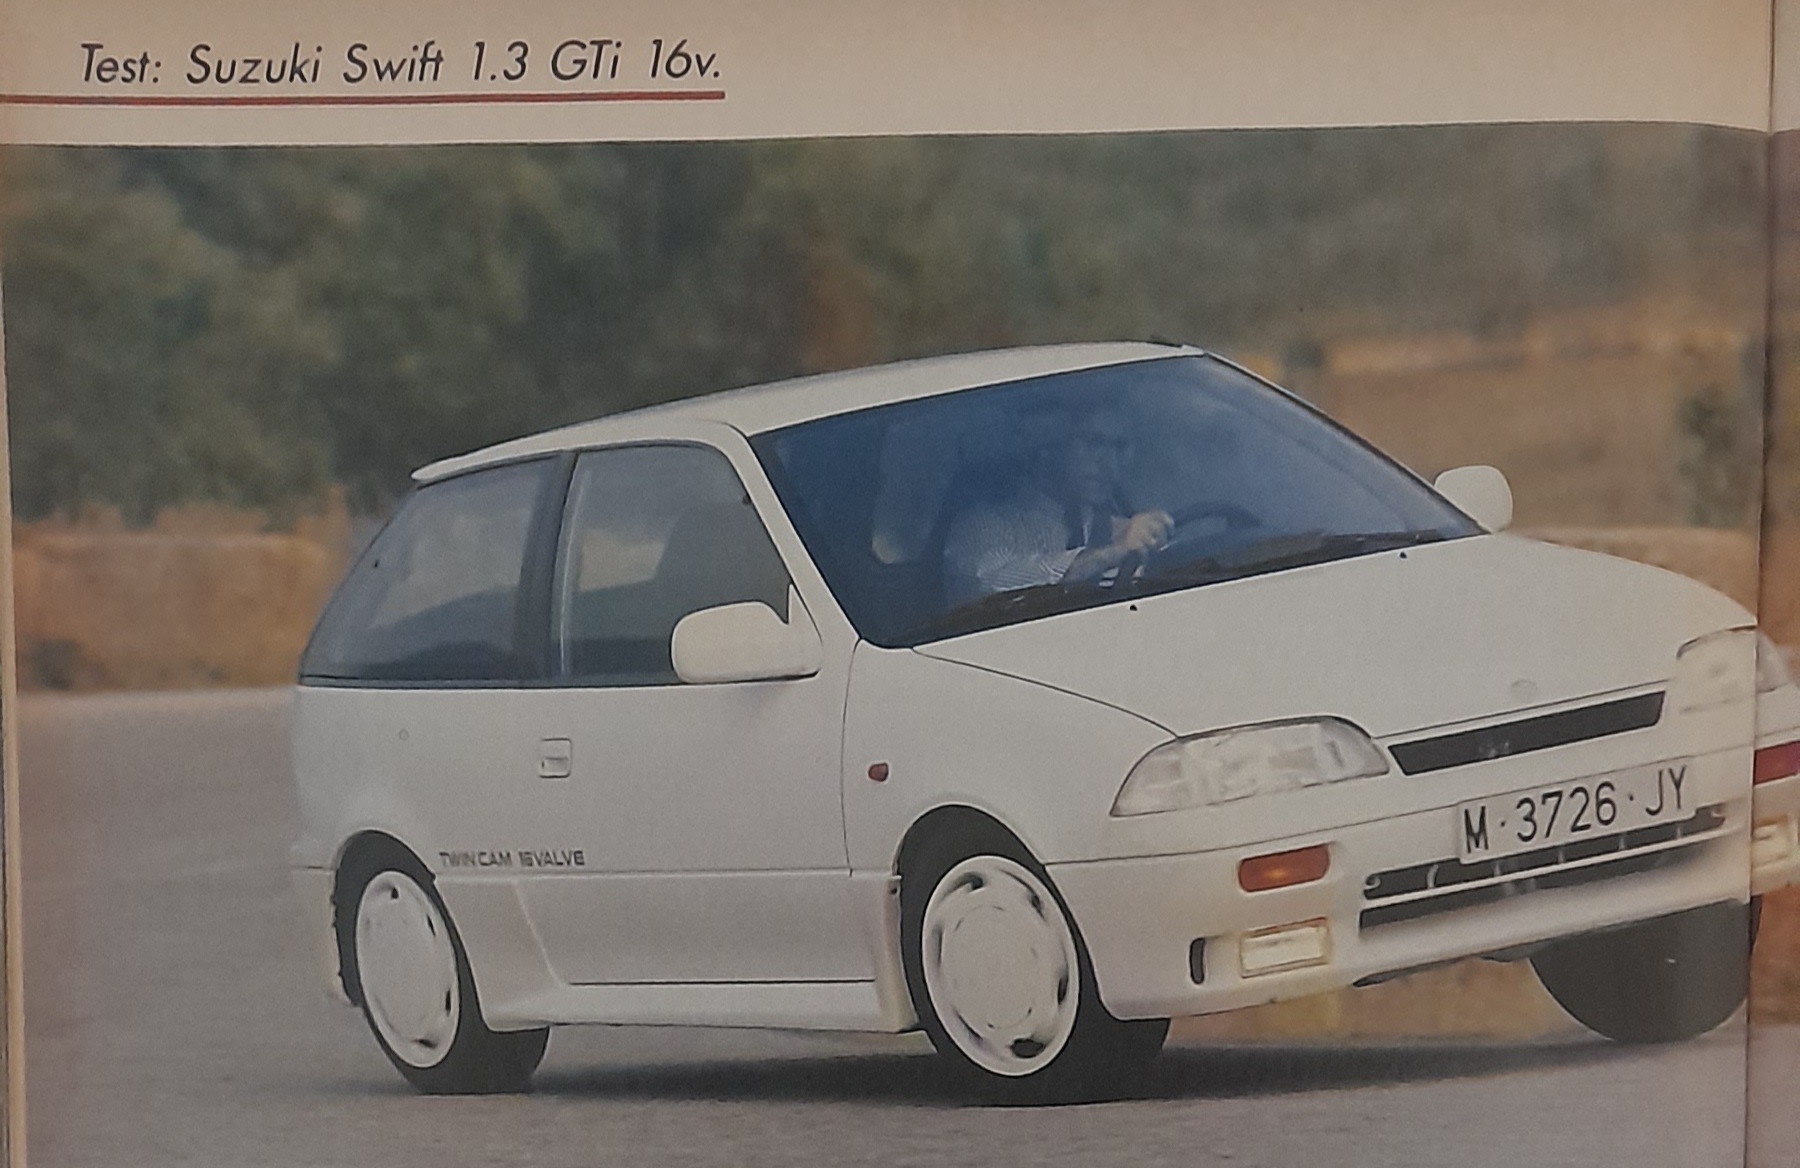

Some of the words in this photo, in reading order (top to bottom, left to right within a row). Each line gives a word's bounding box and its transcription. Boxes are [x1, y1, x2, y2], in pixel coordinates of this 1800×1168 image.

[80, 42, 162, 83] Test:
[186, 42, 323, 84] Suzuki
[343, 40, 444, 84] Swift
[474, 41, 529, 81] 1.3
[551, 40, 622, 80] GTi
[650, 39, 720, 79] 16v.
